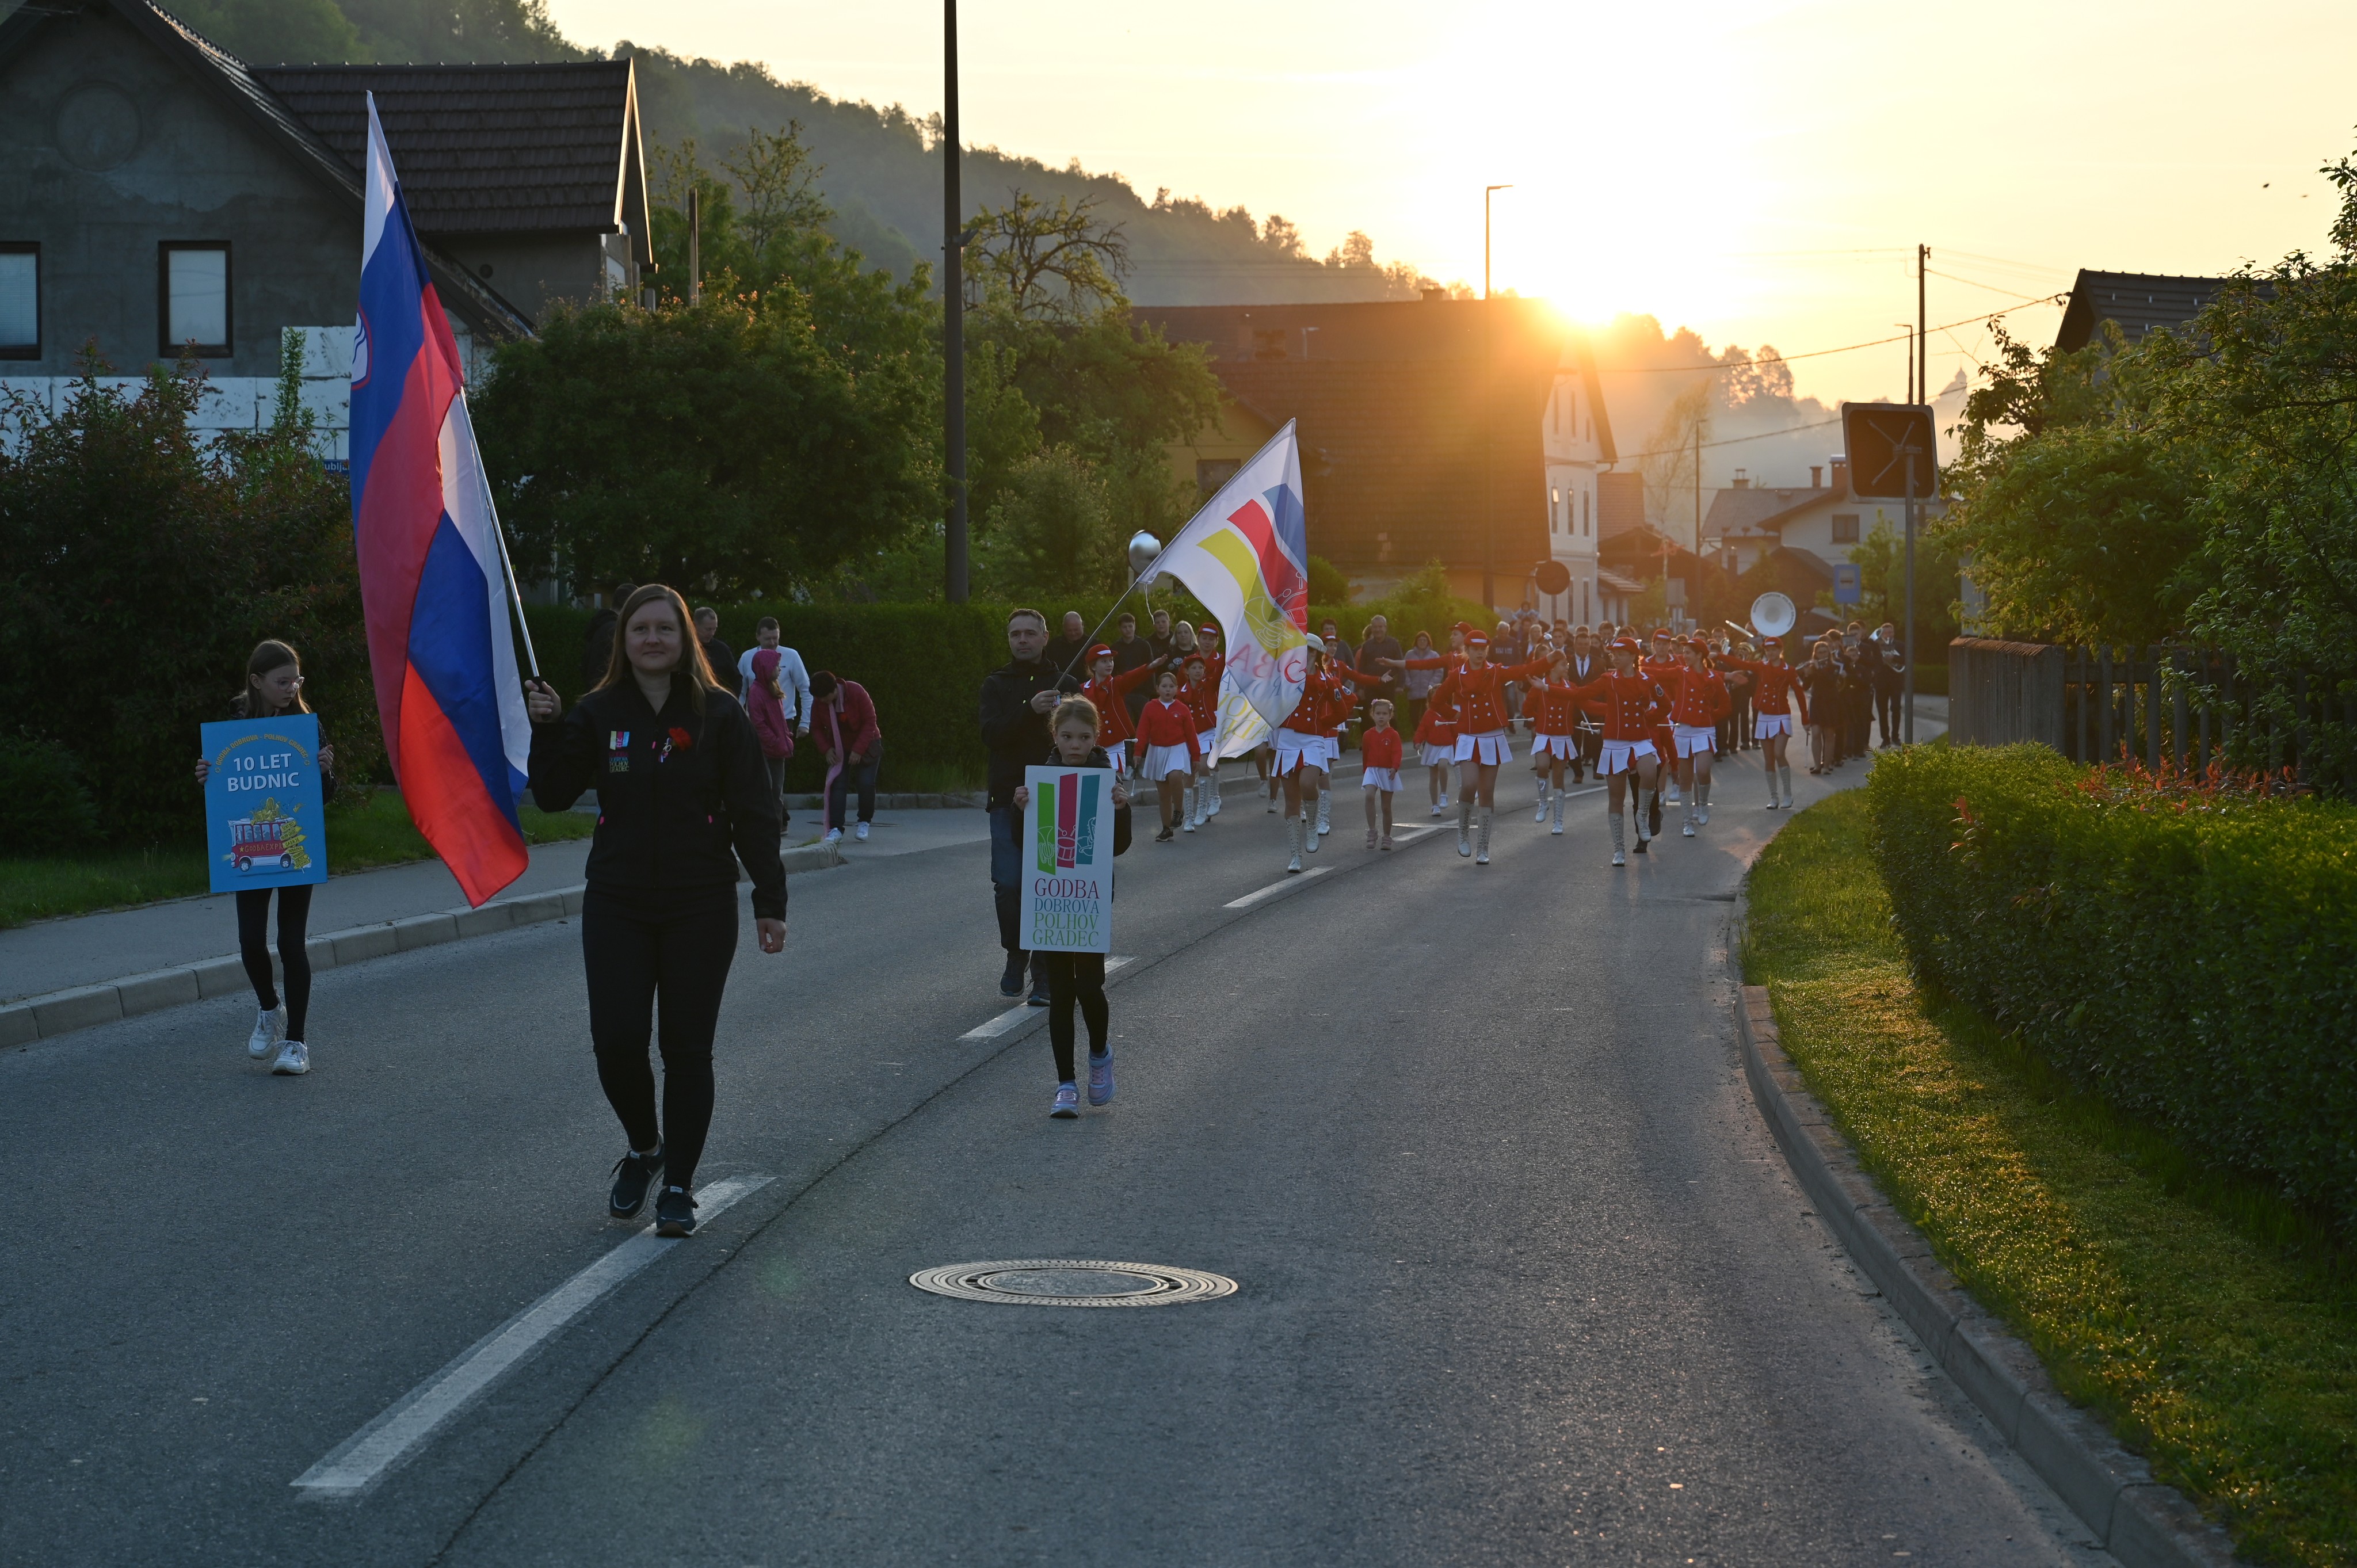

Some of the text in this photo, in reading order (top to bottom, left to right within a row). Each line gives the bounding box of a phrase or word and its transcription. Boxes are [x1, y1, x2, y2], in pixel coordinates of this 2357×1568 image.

[322, 462, 349, 472] ublja
[216, 747, 231, 765] GODBA
[230, 734, 258, 749] DOBROVA
[264, 733, 288, 743] POLHOV
[288, 739, 309, 758] GRADEC
[234, 753, 292, 772] 10 LET
[228, 772, 299, 792] BUDNIC
[1035, 878, 1100, 899] GODBA
[1034, 898, 1100, 914] DOBROVA
[1033, 912, 1099, 930] POLHOV
[1032, 929, 1099, 947] GRADEC
